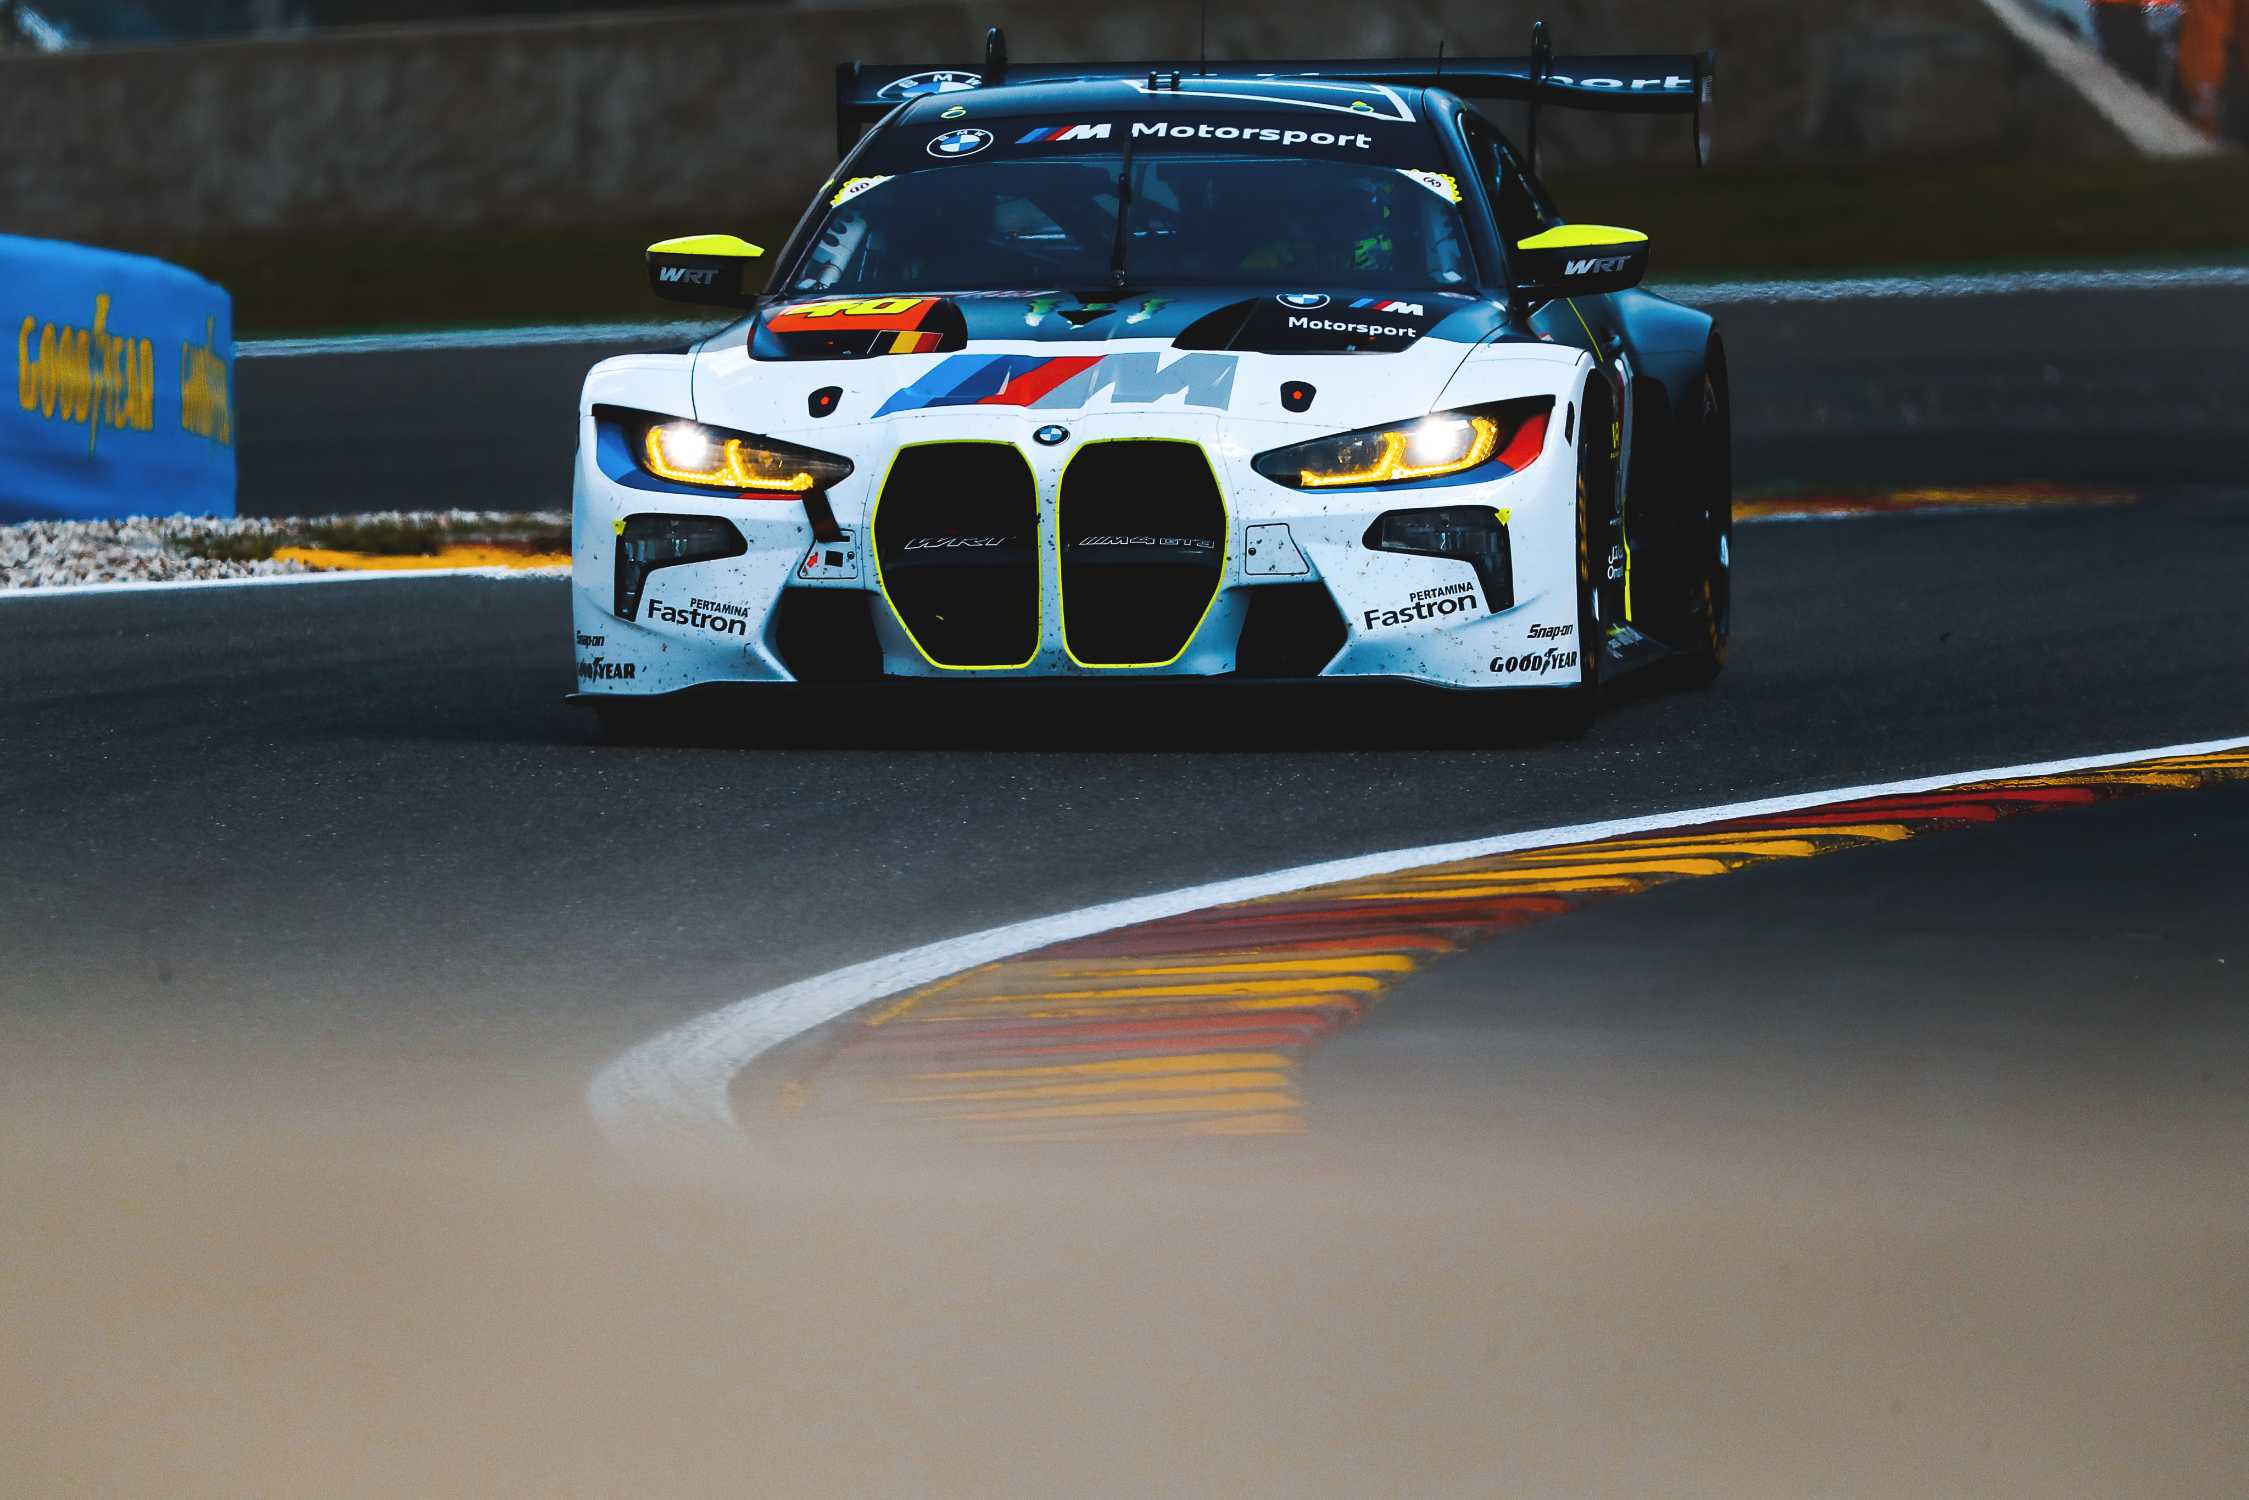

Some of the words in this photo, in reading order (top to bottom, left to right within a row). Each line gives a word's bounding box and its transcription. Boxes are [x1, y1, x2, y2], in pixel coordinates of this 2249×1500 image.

[1131, 122, 1372, 149] Motorsport
[659, 266, 720, 286] WRT
[1563, 255, 1632, 276] WRT
[1288, 316, 1417, 338] Motorsport
[1409, 581, 1475, 603] PERTAMINA
[647, 598, 748, 636] Fastron
[689, 597, 750, 619] PERTAMINA
[1363, 593, 1478, 631] Fastron
[1526, 623, 1574, 641] Snap-on
[1489, 647, 1578, 676] GOODYEAR
